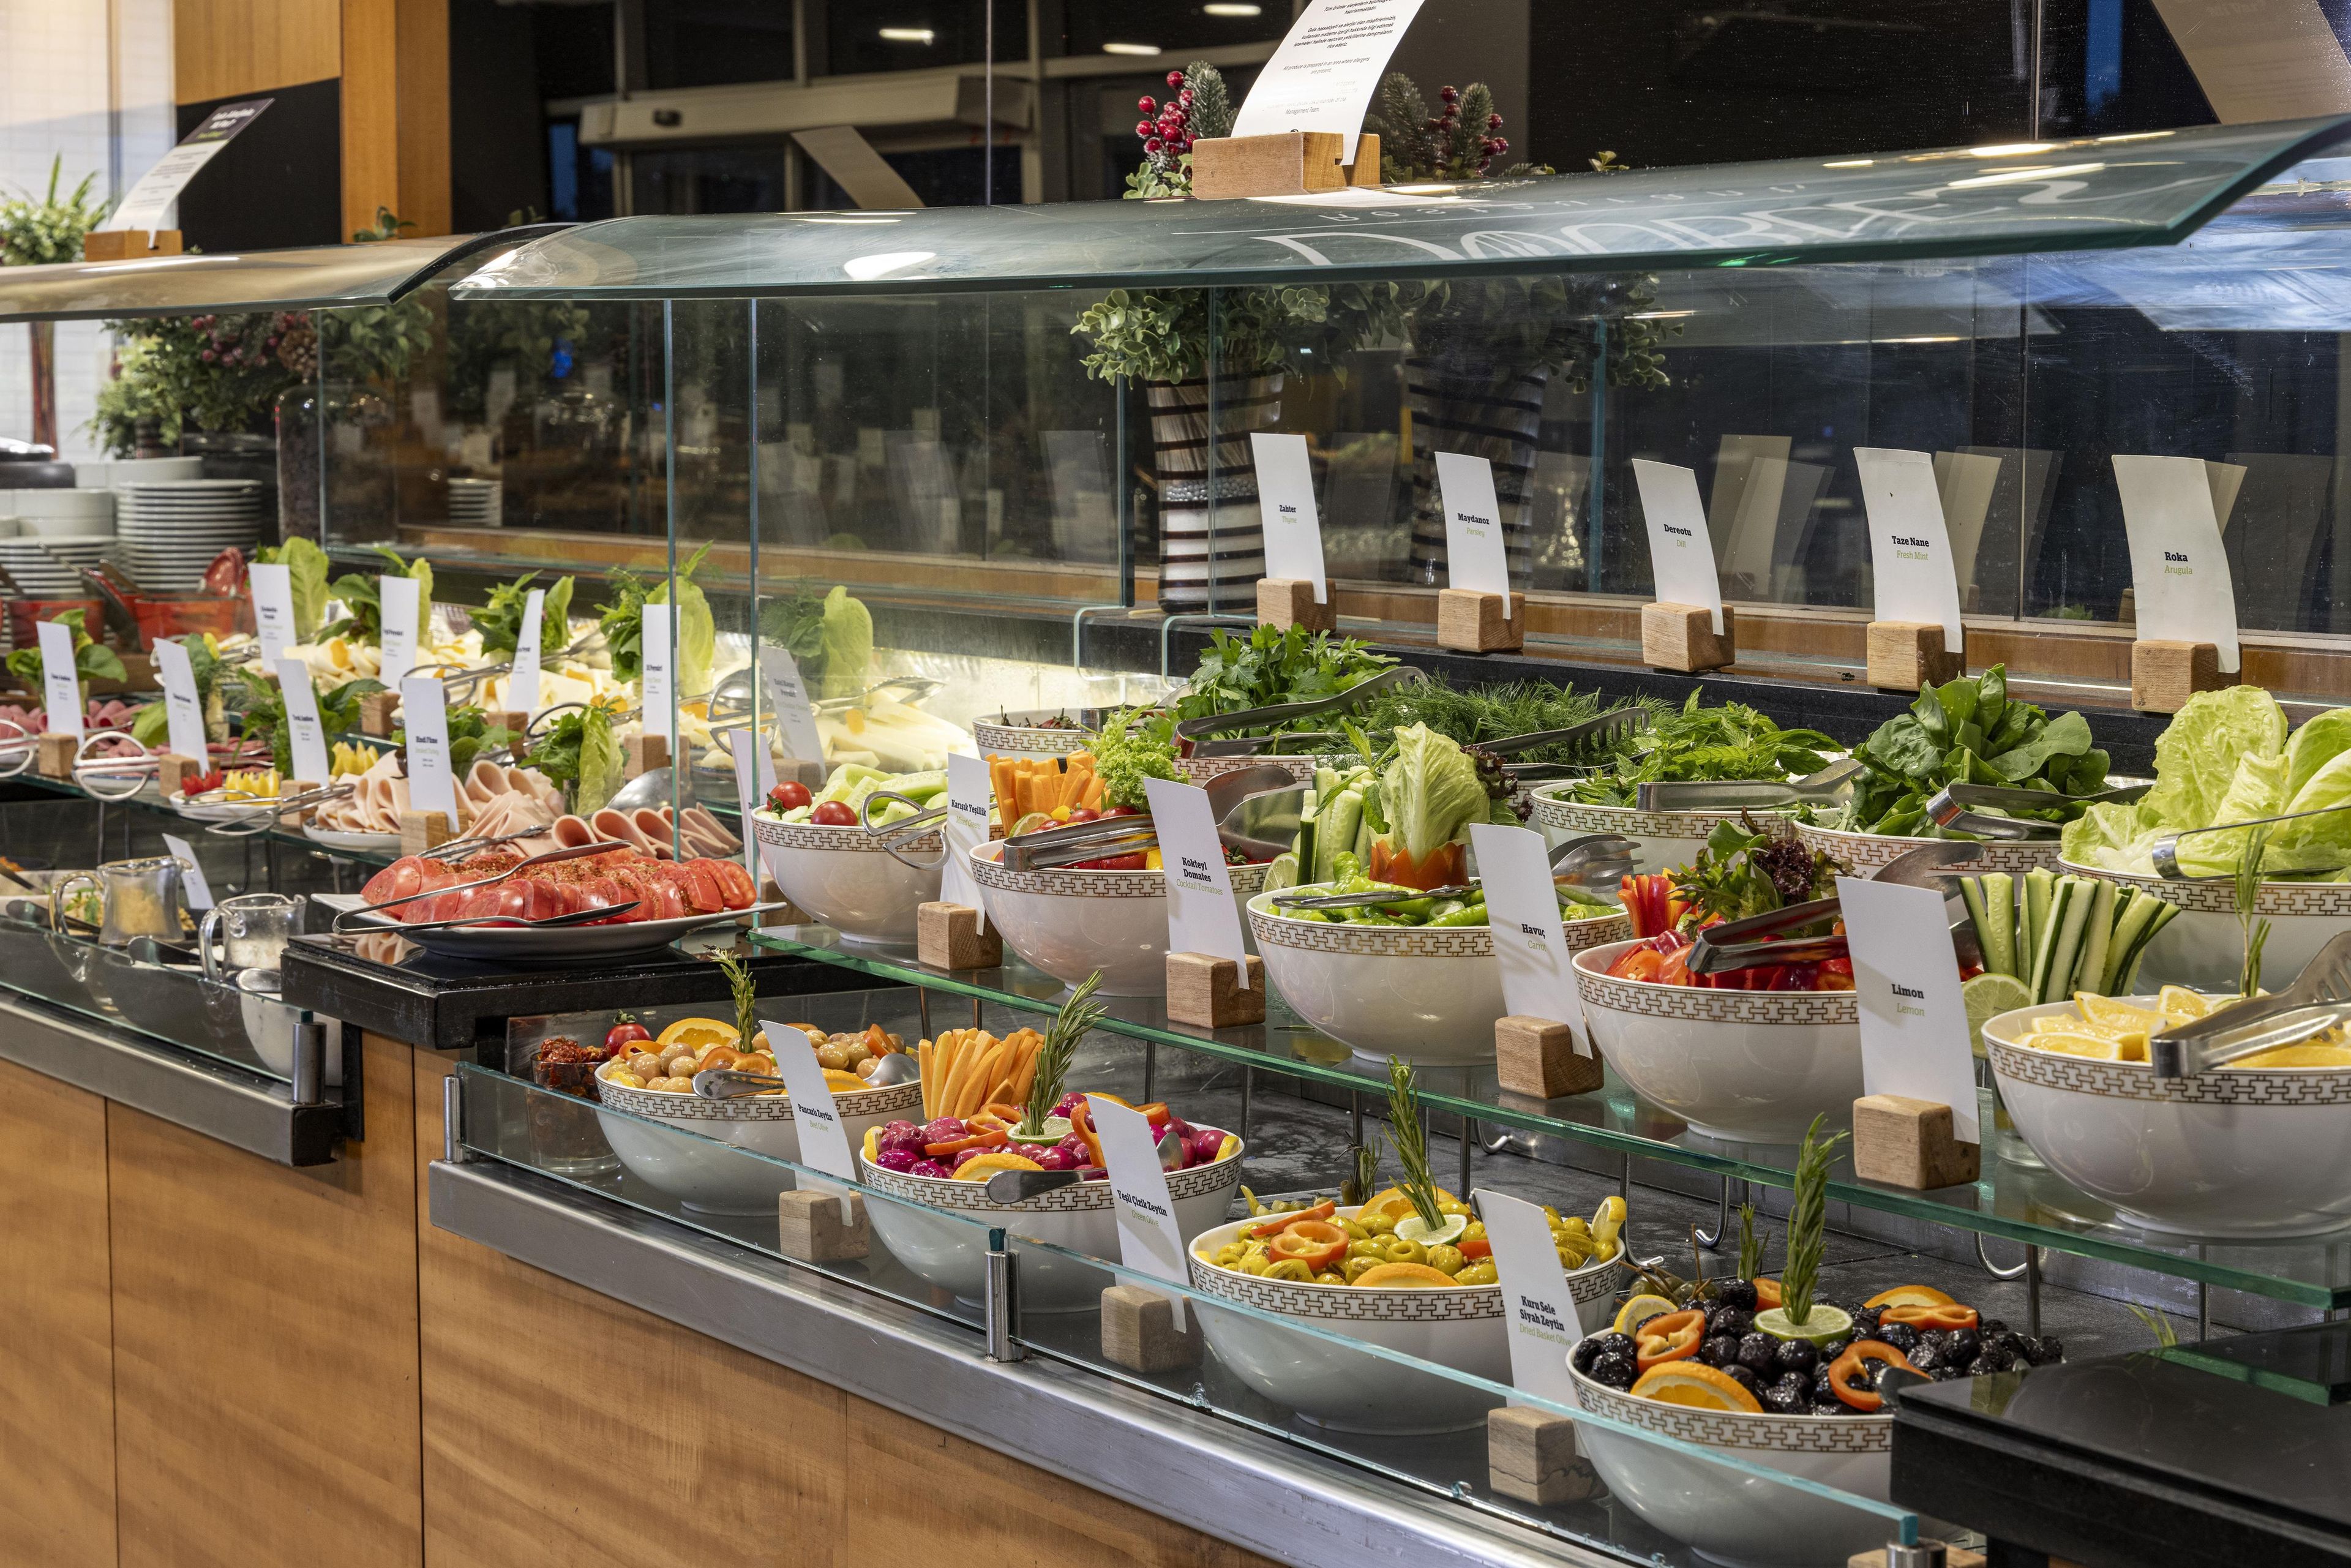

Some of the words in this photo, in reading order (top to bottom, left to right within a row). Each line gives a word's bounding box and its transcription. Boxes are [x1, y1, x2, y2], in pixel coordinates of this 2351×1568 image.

[1458, 513, 1490, 525] Maydanoz
[1467, 527, 1485, 538] Parsley
[1664, 524, 1692, 536] Dereotu
[1677, 539, 1685, 548] Dill
[1892, 536, 1909, 545] Taze
[1910, 538, 1929, 547] Nane
[1897, 550, 1913, 559] Fresh
[1914, 552, 1928, 560] Mint
[2164, 552, 2188, 561] Roka
[2164, 565, 2192, 576] Arugula
[951, 800, 968, 811] Karışık
[969, 804, 986, 816] Yeşillik
[1182, 857, 1207, 871] Kokteyl
[1183, 869, 1211, 884] Domates
[1177, 879, 1198, 890] Cocktail
[1198, 883, 1223, 895] Tomatoes
[1521, 924, 1545, 939] Havuç
[1528, 940, 1547, 951] Carrot
[1891, 984, 1924, 999] Limon
[1897, 1002, 1925, 1016] Lemon
[798, 1104, 817, 1117] Pancarlı
[817, 1109, 833, 1121] Zeytin
[1117, 1190, 1132, 1203] Yeşil
[1132, 1196, 1147, 1209] Çizik
[1147, 1201, 1167, 1216] Zeytin
[1131, 1210, 1146, 1221] Green
[1521, 1296, 1540, 1310] Kuru
[1540, 1302, 1556, 1315] Sele
[1520, 1309, 1540, 1324] Siyah
[1540, 1315, 1565, 1331] Zeytin
[1519, 1323, 1535, 1337] Dried
[1536, 1328, 1555, 1342] Basket
